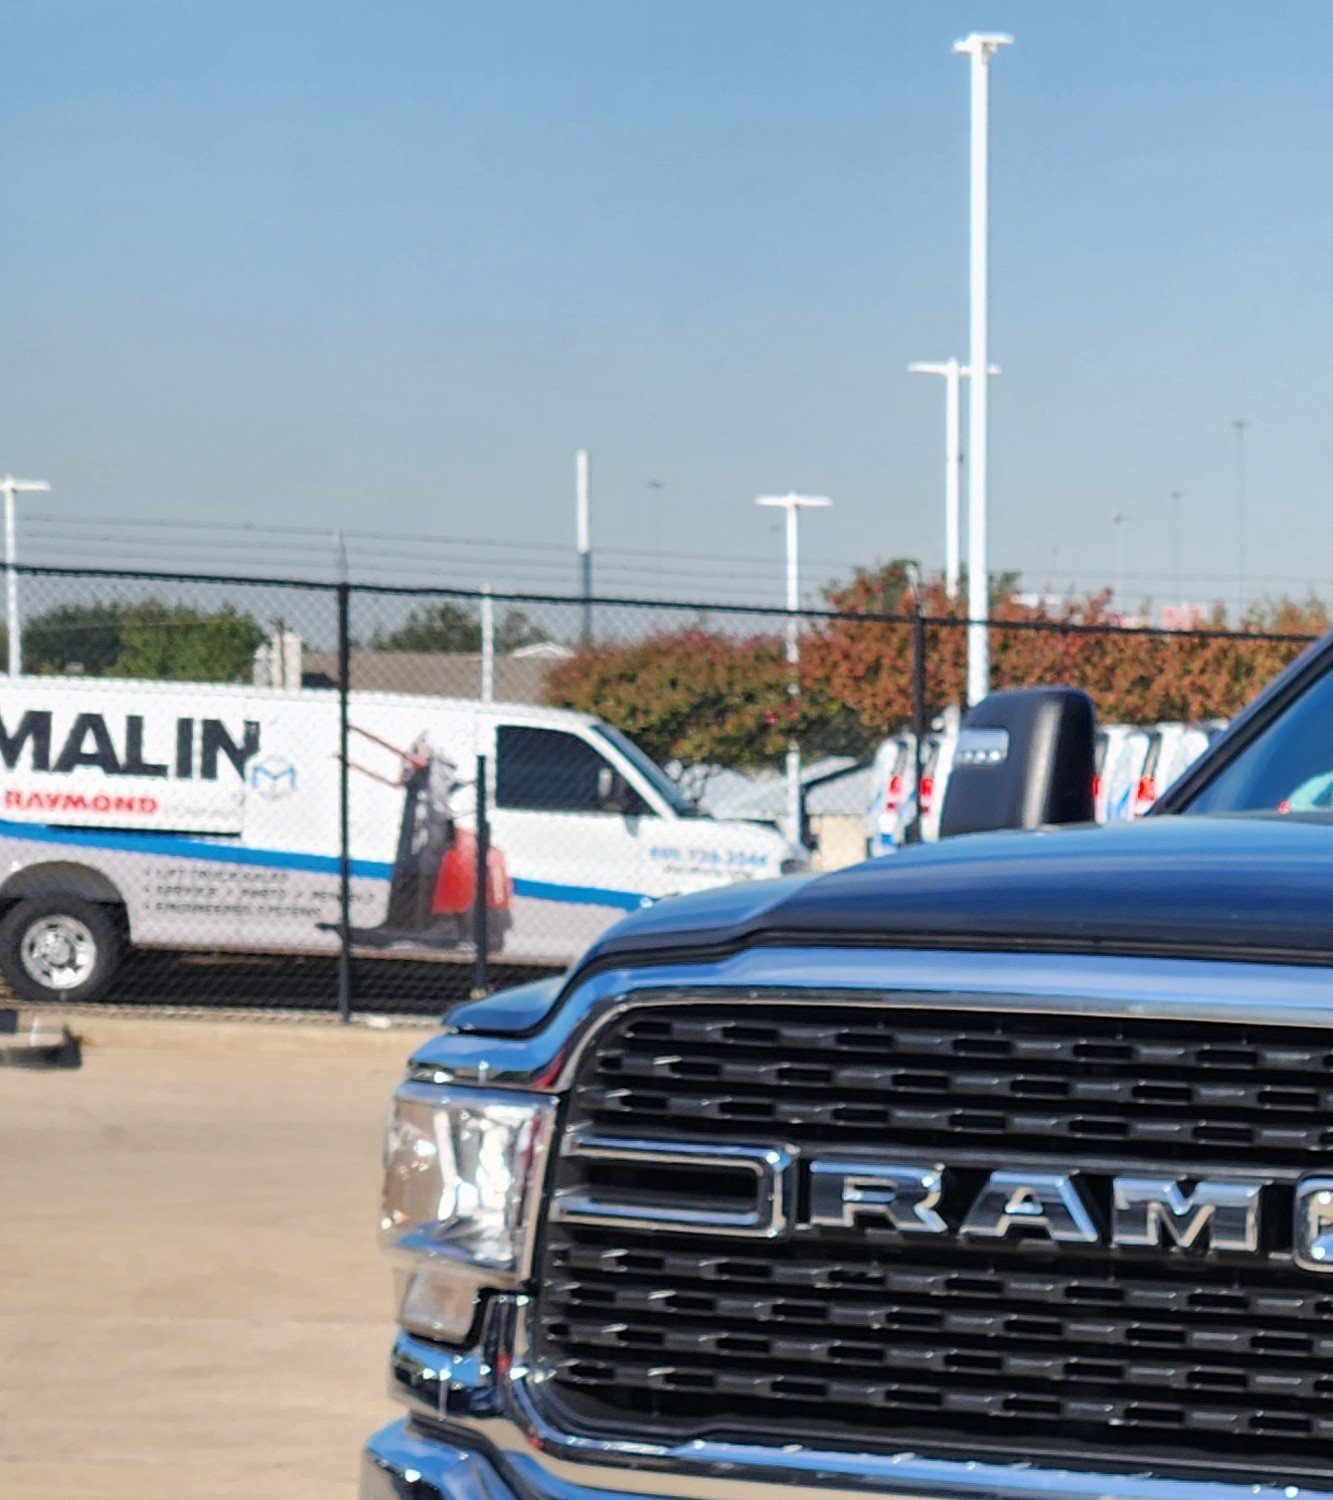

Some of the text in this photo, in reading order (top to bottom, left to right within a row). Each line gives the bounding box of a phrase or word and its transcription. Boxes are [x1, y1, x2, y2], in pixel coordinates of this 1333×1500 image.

[0, 711, 260, 781] MALIN
[5, 790, 158, 814] RAYMOND
[810, 1162, 1260, 1251] RAM
